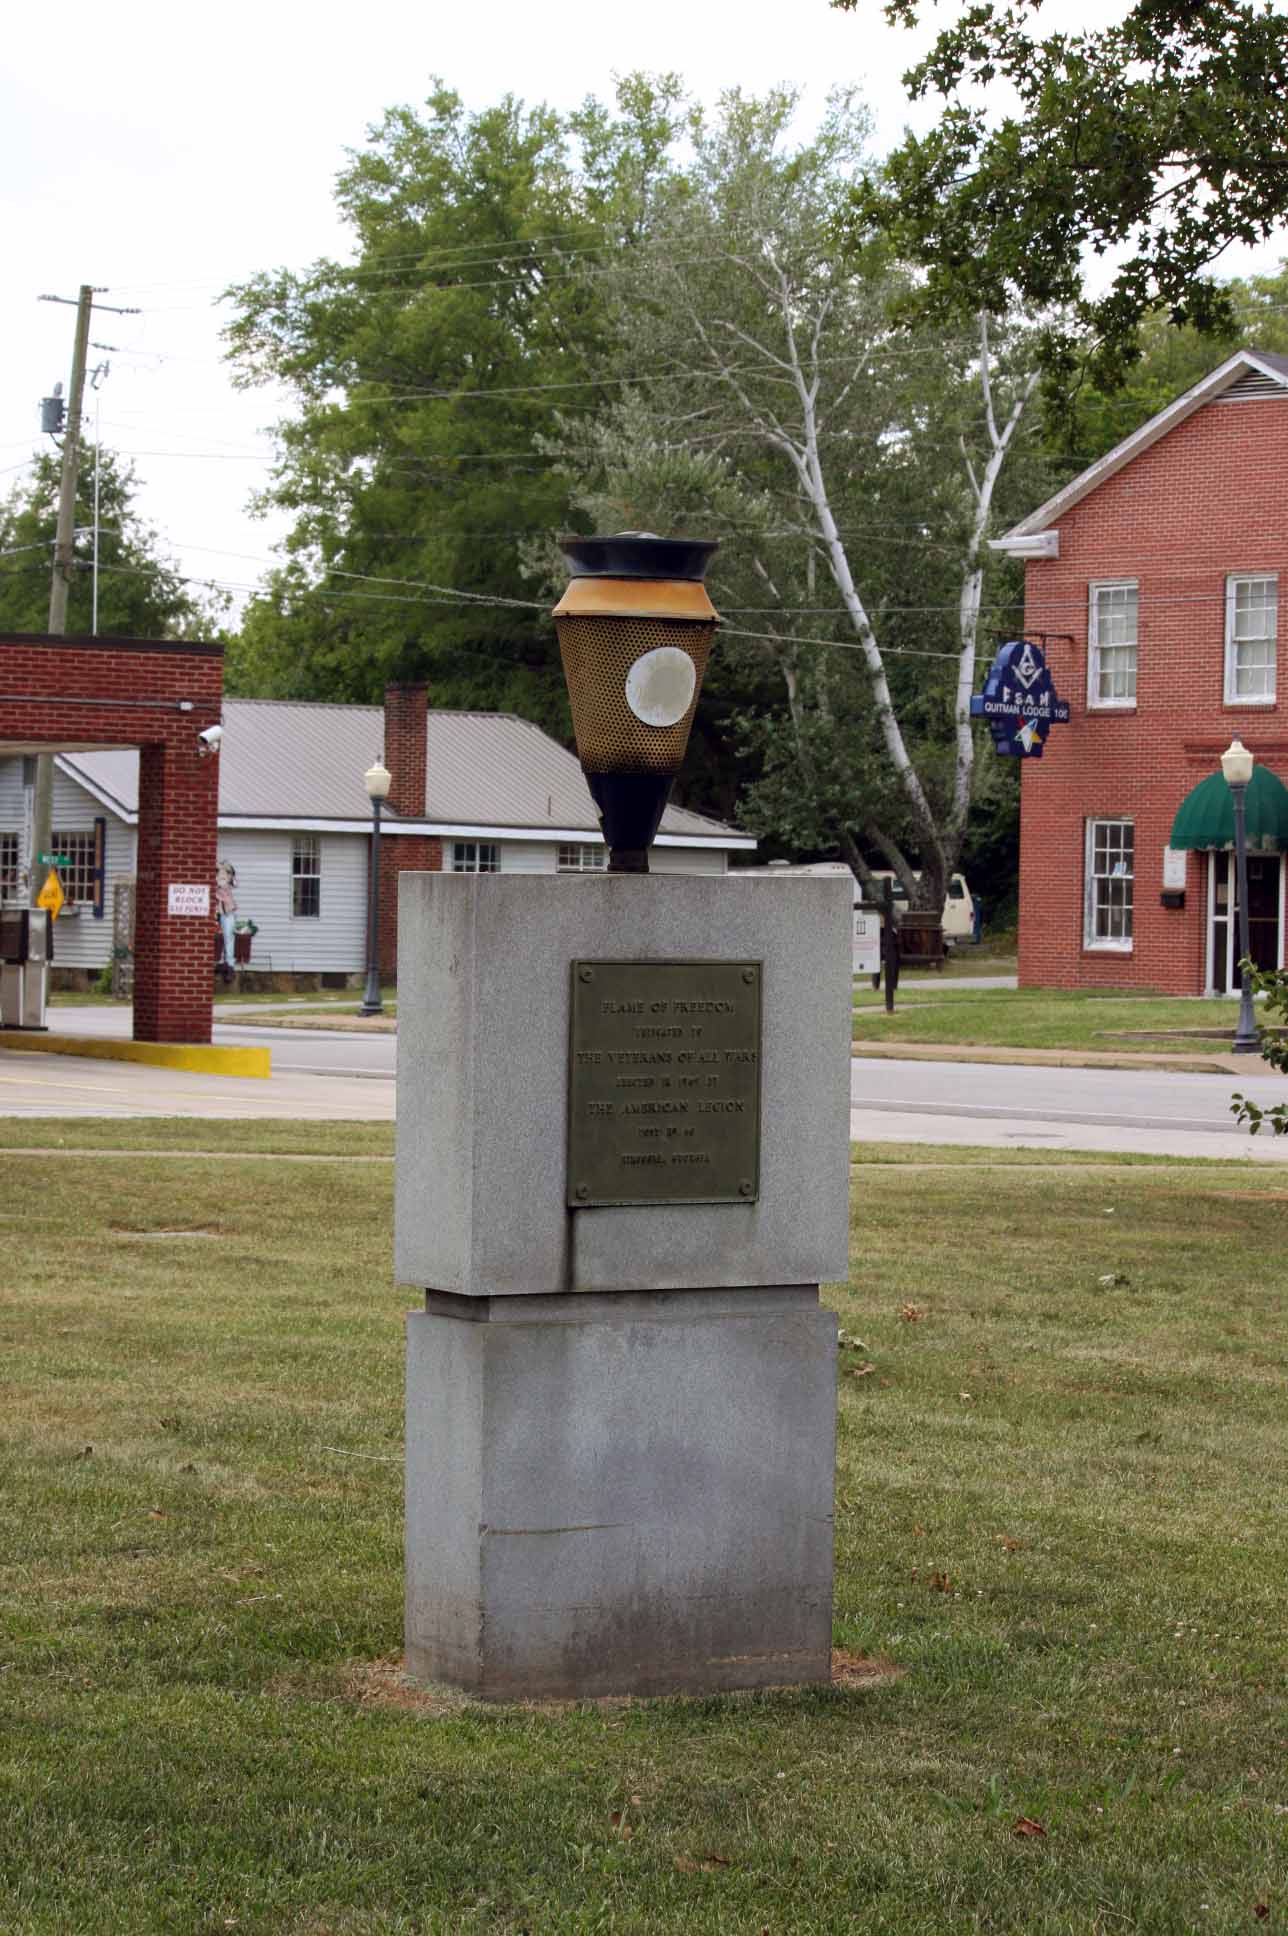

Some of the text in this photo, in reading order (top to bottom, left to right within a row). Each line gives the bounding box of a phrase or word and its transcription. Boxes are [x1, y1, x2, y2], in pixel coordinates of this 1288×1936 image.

[984, 702, 1020, 714] QUITMAN
[1022, 705, 1051, 717] LODGE
[600, 1000, 736, 1014] FLAME OF FREEDOM
[576, 1051, 758, 1064] THE VETERANS OF ALL WARS
[587, 1099, 745, 1115] THE AMERICAN LEGION
